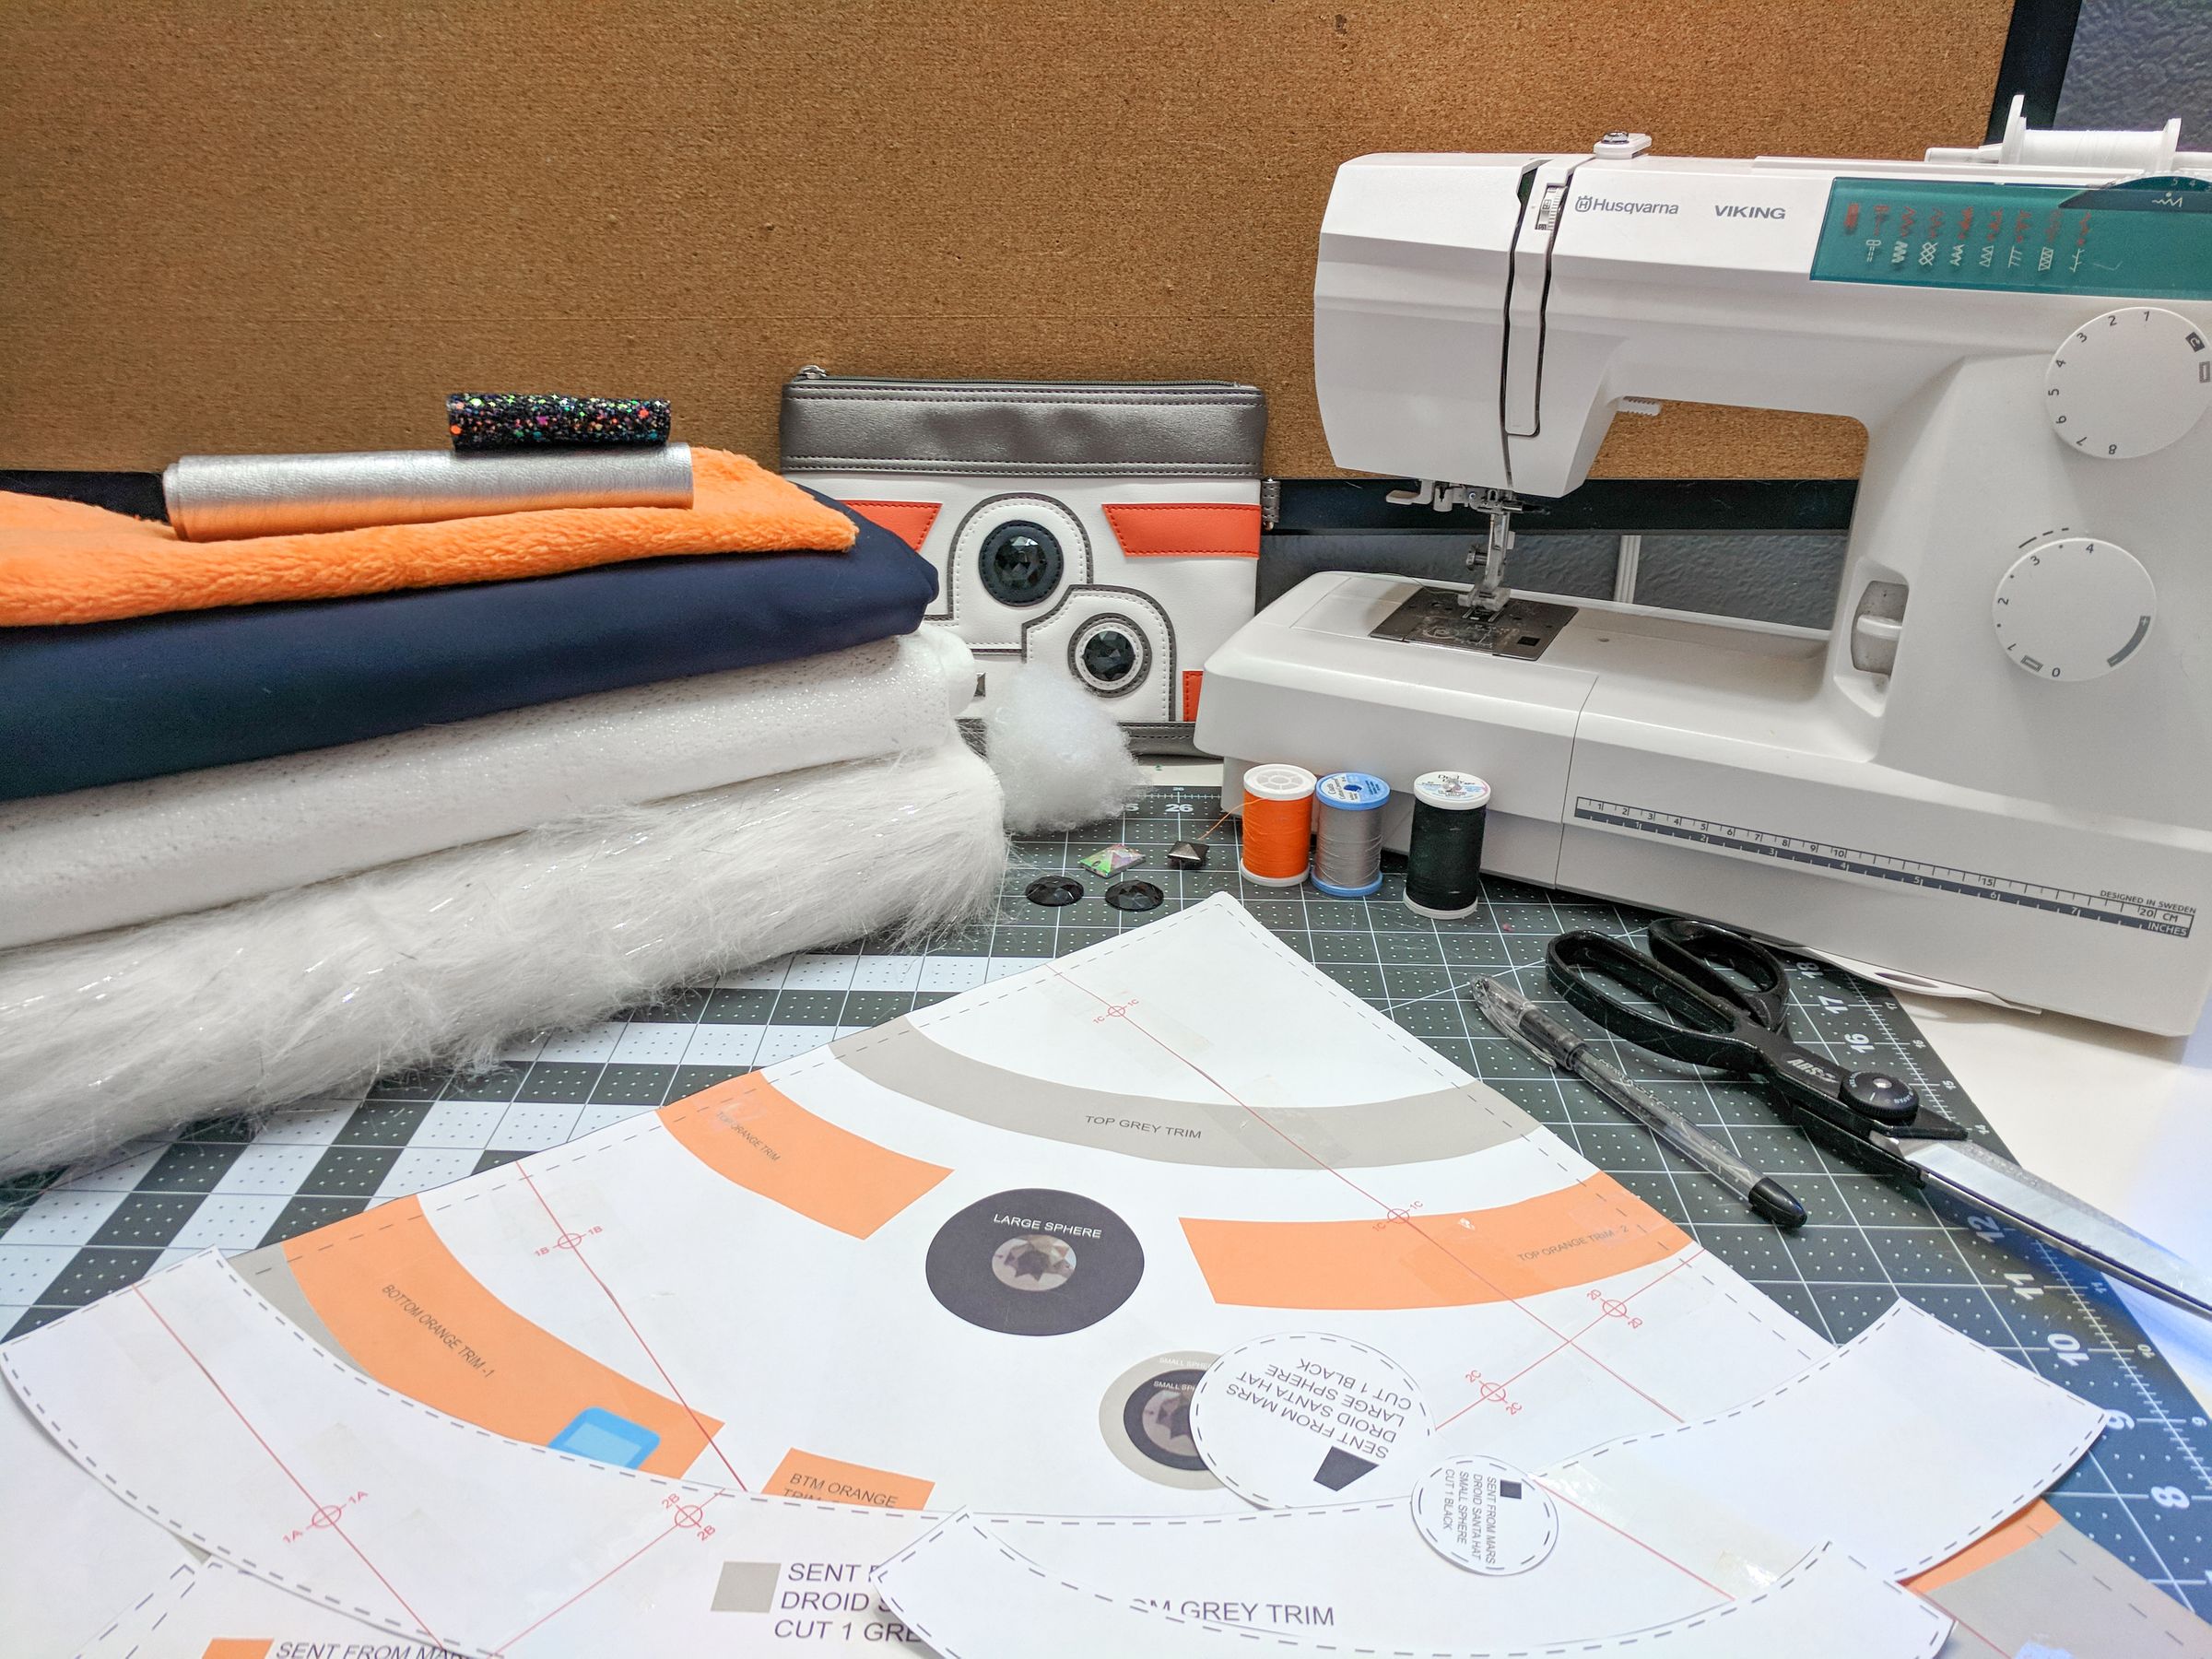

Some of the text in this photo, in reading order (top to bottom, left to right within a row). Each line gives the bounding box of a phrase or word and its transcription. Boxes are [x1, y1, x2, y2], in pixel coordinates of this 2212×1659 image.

[1594, 198, 1786, 219] Husqvarna VIKING
[2108, 315, 2117, 326] 2
[2144, 311, 2150, 321] 1
[2077, 332, 2088, 343] 3
[2055, 359, 2066, 368] 4
[2048, 388, 2059, 396] 5
[2055, 415, 2066, 424] 6
[2076, 436, 2088, 446] 7
[2108, 443, 2117, 455] 8
[2086, 543, 2094, 554] 4
[2030, 555, 2041, 566] 3
[1997, 597, 2009, 606] 2
[2006, 642, 2017, 652] 1
[2052, 667, 2061, 677] 0
[1124, 803, 1194, 812] 5 26
[1622, 807, 1628, 816] 2
[1673, 818, 1679, 826] 4
[1700, 823, 1706, 831] 5
[1754, 833, 1760, 841] 7
[1810, 844, 1817, 853] 9
[1834, 849, 1844, 857] 10
[1982, 877, 1994, 887] 15
[2139, 908, 2154, 917] 20
[2162, 912, 2179, 923] CM
[1769, 847, 1775, 855] 3
[1913, 876, 1922, 885] 5
[1990, 890, 1997, 900] 6
[2071, 906, 2079, 915] 7
[2147, 922, 2187, 936] INCHES
[2100, 889, 2144, 904] DESIGNED
[2158, 900, 2196, 913] SWEDEN
[1796, 961, 1824, 979] 18
[1127, 998, 1139, 1007] 1C
[1818, 994, 1849, 1014] 17
[1885, 1002, 1899, 1010] 17
[1092, 1016, 1105, 1024] 1C
[1844, 1033, 1875, 1053] 16
[1912, 1040, 1926, 1049] 16
[1943, 1080, 1957, 1090] 15
[1086, 1115, 1202, 1139] TOP GREY TRIM
[1975, 1124, 1989, 1135] 14
[731, 1124, 763, 1147] ORANGE
[760, 1145, 781, 1161] TRIM
[1409, 1200, 1424, 1211] 1C
[588, 1226, 603, 1235] 1B
[994, 1213, 1102, 1239] LARGE SPHERE
[1371, 1221, 1386, 1232] 1C
[1967, 1215, 2005, 1242] 12
[535, 1247, 549, 1256] 1B
[1517, 1252, 1539, 1262] TOP
[1541, 1237, 1588, 1256] ORANGE
[1588, 1229, 1615, 1243] TRIM
[1586, 1288, 1602, 1301] 2D
[2004, 1273, 2044, 1300] 11
[382, 1284, 424, 1317] BOTTOM
[419, 1314, 462, 1349] ORANGE
[458, 1346, 486, 1370] TRIM
[1628, 1317, 1643, 1329] 2D
[2047, 1334, 2089, 1366] 10
[2136, 1343, 2156, 1359] 10
[1159, 1357, 1184, 1367] SMALL
[1297, 1358, 1412, 1410] CUT 1 BLACK
[1465, 1370, 1481, 1382] 2C
[1153, 1380, 1180, 1391] SMALL
[1265, 1364, 1405, 1427] LARGE SPHERE
[1236, 1371, 1397, 1443] DROID SANTA HAT
[1506, 1402, 1523, 1416] 2C
[1226, 1382, 1389, 1459] SENT FROM MARS
[2192, 1416, 2207, 1427] 9
[1445, 1468, 1455, 1488] CUT
[348, 1490, 369, 1504] 1A
[790, 1473, 899, 1508] BTM ORANGE
[2150, 1486, 2190, 1509] 8
[661, 1492, 680, 1510] 2B
[1457, 1471, 1469, 1545] SMALL SPHERE
[1443, 1497, 1453, 1530] BLACK
[1472, 1474, 1483, 1560] DROID SANTA HAT
[1486, 1476, 1497, 1564] SENT FROM MARS
[282, 1530, 303, 1543] 1A
[697, 1524, 716, 1542] 2B
[788, 1563, 862, 1583] SENT
[782, 1591, 869, 1611] DROID
[1181, 1600, 1258, 1621] GREY
[1265, 1604, 1335, 1626] TRIM
[774, 1619, 922, 1642] CUT 1 GRE
[276, 1641, 341, 1659] SENT
[343, 1644, 411, 1659] FROM
